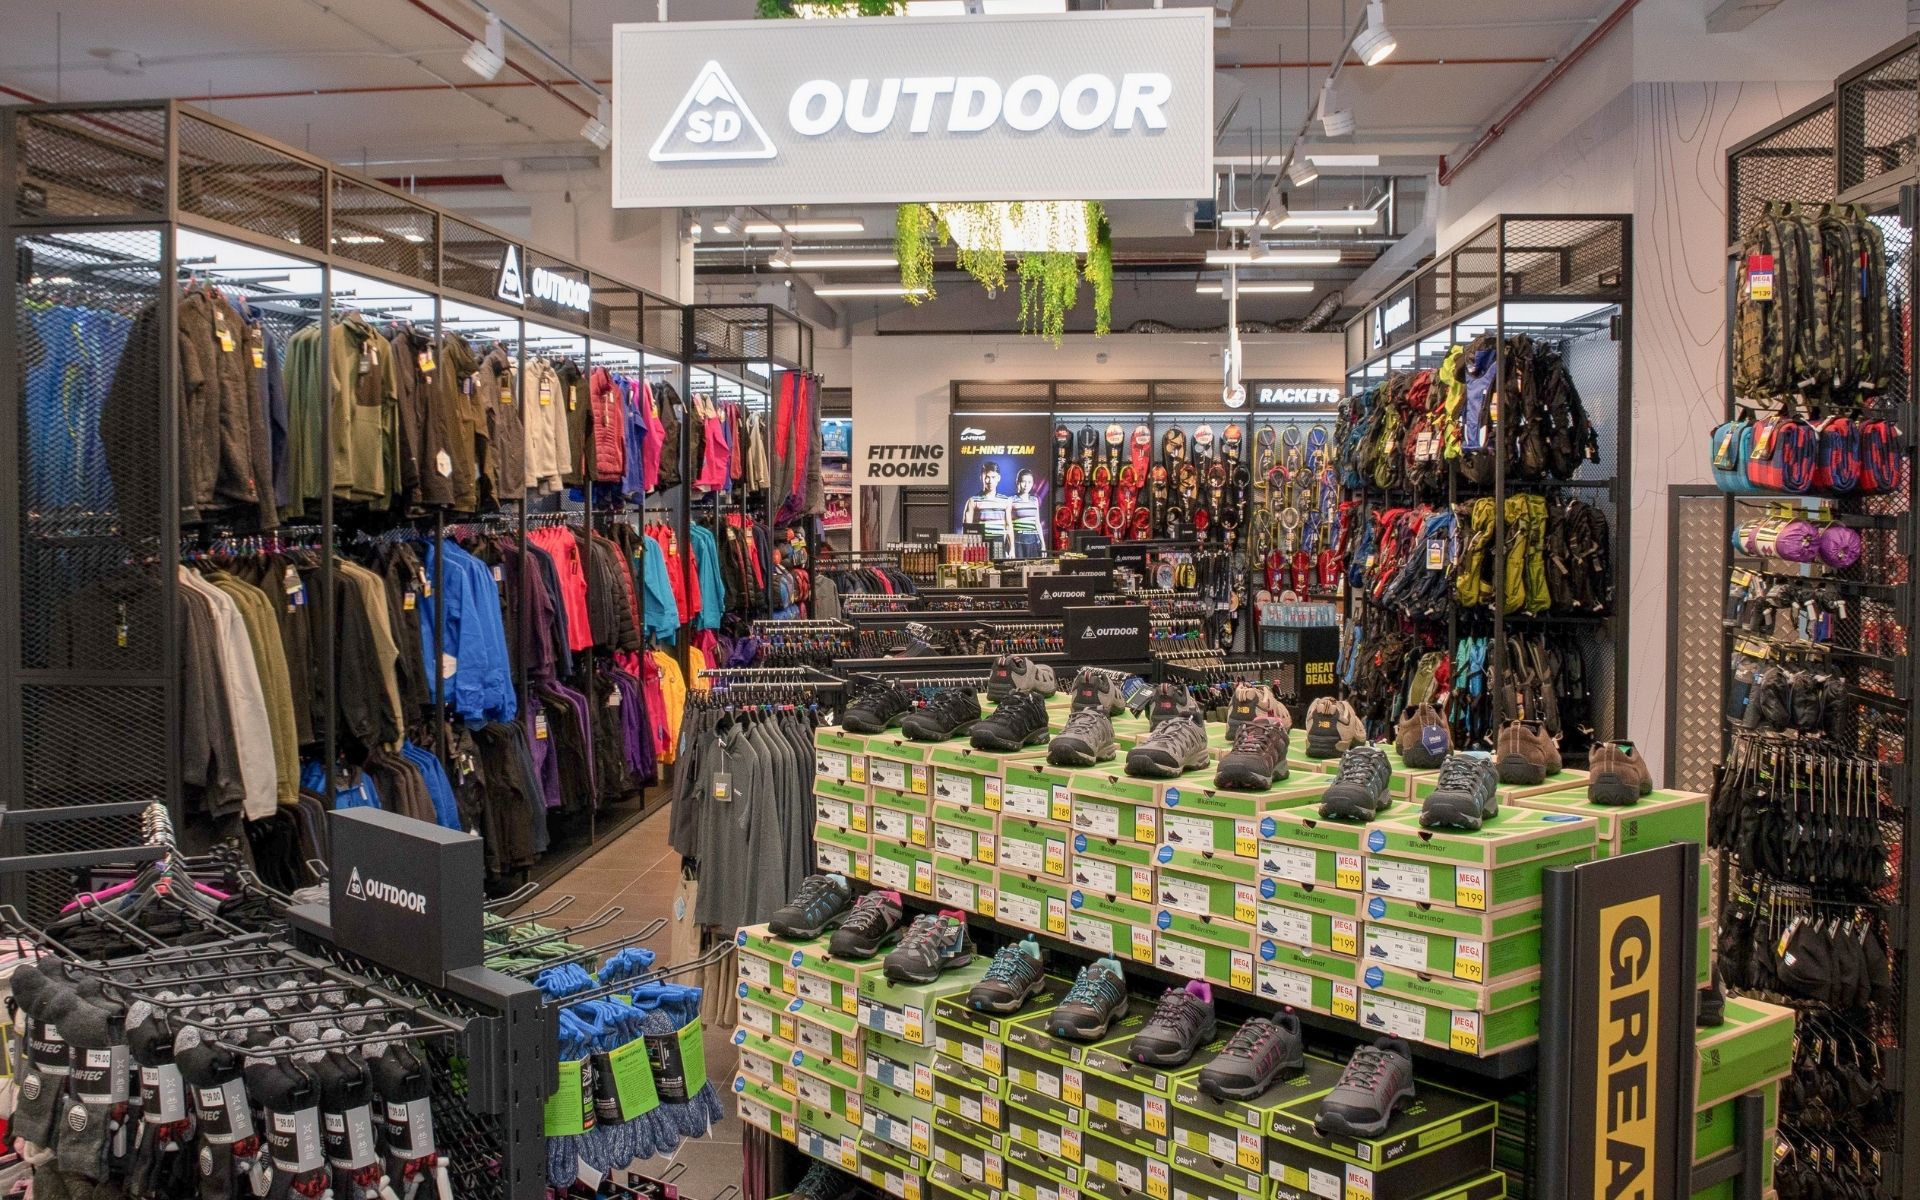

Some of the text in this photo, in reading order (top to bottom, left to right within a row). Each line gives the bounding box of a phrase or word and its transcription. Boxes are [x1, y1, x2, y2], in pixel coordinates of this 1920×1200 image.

[686, 73, 1172, 143] SD OUTDOOR
[532, 267, 591, 312] OUTDOOR
[1260, 388, 1340, 403] RACKETS
[868, 445, 944, 459] FITTING
[960, 445, 1035, 455] #LI-NING TEAM
[868, 462, 940, 477] ROOMS
[1096, 627, 1139, 636] OUTDOOR
[1305, 662, 1334, 673] GREAT
[1305, 673, 1334, 685] DEALS
[1138, 814, 1153, 822] MEGA
[1238, 826, 1254, 836] MEGA
[1340, 856, 1358, 867] MEGA
[1134, 871, 1149, 882] MEGA
[1459, 873, 1480, 887] MEGA
[366, 878, 427, 915] OUTDOOR
[1238, 892, 1254, 902] MEGA
[1334, 920, 1353, 932] MEGA
[1135, 933, 1150, 942] MEGA
[1460, 945, 1479, 957] MEGA
[1233, 958, 1249, 969] MEGA
[1335, 985, 1353, 998] MEGA
[1455, 1017, 1474, 1029] MEGA
[32, 1041, 62, 1054] HI-TEC
[1605, 914, 1652, 1200] GREA
[75, 1070, 103, 1081] HI-TEC
[1148, 1101, 1164, 1113] MEGA
[1241, 1136, 1258, 1148] MEGA
[1149, 1166, 1166, 1178] MEGA
[1349, 1173, 1370, 1188] MEGA
